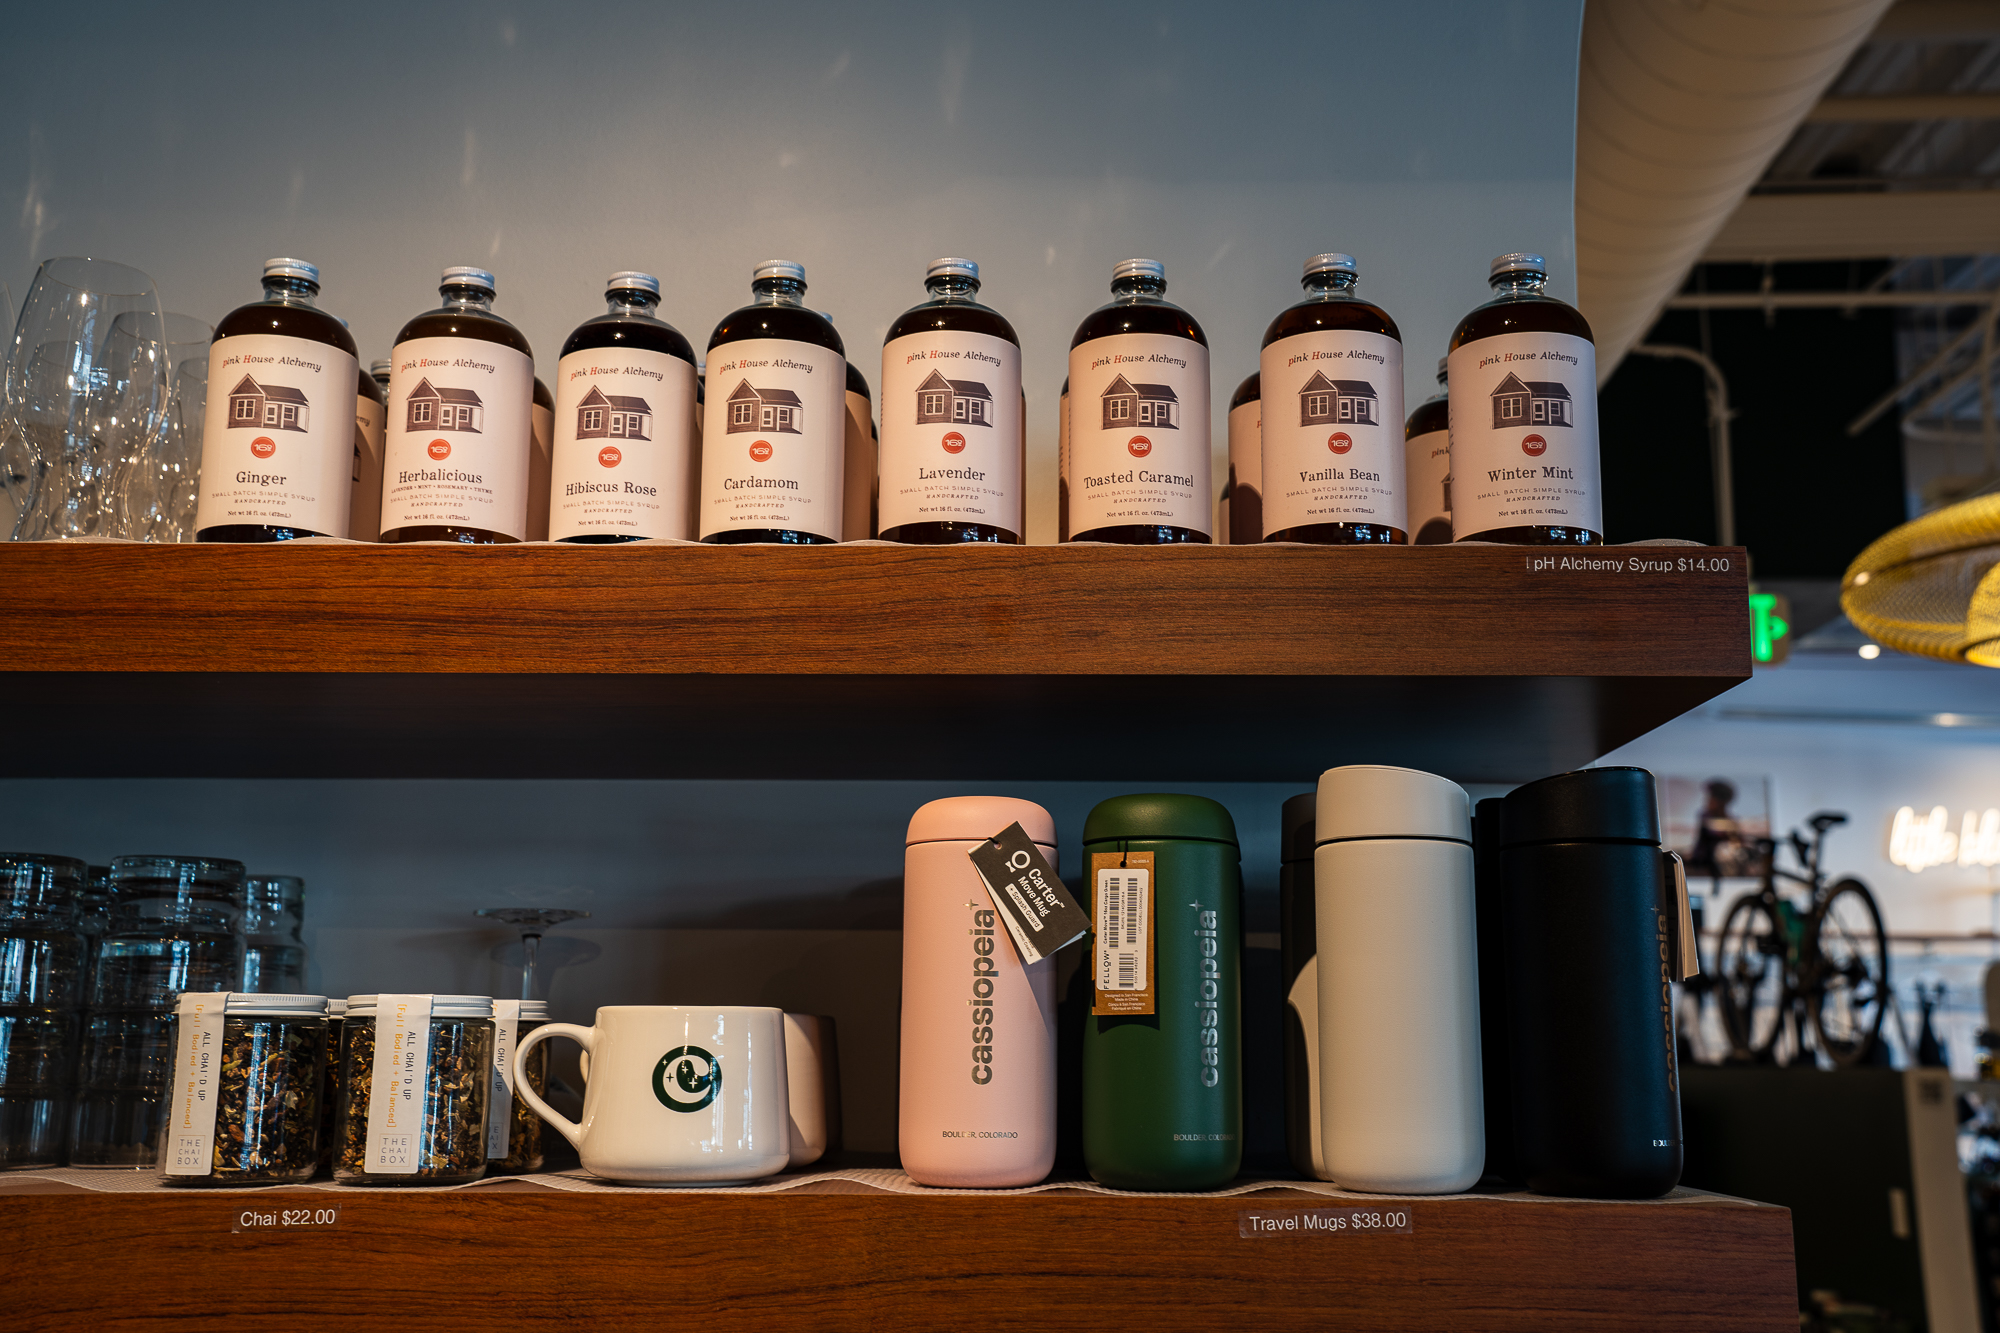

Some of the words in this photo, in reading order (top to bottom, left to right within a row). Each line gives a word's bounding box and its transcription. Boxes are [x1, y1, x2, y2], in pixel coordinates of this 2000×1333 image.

[222, 356, 241, 368] pink
[243, 355, 274, 364] House
[278, 356, 322, 373] Alchemy
[401, 360, 417, 373] pink
[420, 359, 449, 367] House
[452, 359, 495, 373] Alchemy
[907, 351, 927, 364] pink
[929, 350, 960, 359] House
[963, 351, 1001, 367] Alchemy
[1091, 357, 1111, 370] pink
[1114, 355, 1144, 364] House
[1148, 354, 1187, 369] Alchemy
[1288, 353, 1309, 367] pink
[1312, 351, 1343, 360] House
[1347, 350, 1385, 364] Alchemy
[1479, 355, 1501, 369] pink
[1504, 352, 1536, 362] House
[1540, 351, 1578, 366] Alchemy
[570, 368, 587, 381] pink
[590, 367, 619, 375] House
[622, 367, 663, 381] Alchemy
[720, 361, 737, 375] pink
[739, 360, 768, 368] House
[772, 359, 813, 373] Alchemy
[236, 471, 287, 486] Ginger
[399, 469, 483, 484] Herbalicious
[919, 467, 986, 481] Lavender
[1084, 470, 1133, 489] Toasted
[1139, 470, 1194, 487] Caramel
[1300, 468, 1344, 482] Vanilla
[1349, 468, 1380, 482] Bean
[1488, 467, 1537, 482] Winter
[1542, 466, 1573, 480] Mint
[566, 481, 619, 496] Hibiscus
[624, 481, 657, 496] Rose
[724, 476, 799, 490] Cardamom
[291, 494, 316, 502] SYRUP
[983, 488, 1004, 496] SYRUP
[1088, 492, 1109, 500] SMALL
[1477, 491, 1500, 500] SMALL
[468, 496, 494, 504] SYRUP
[1534, 557, 1555, 571] pH
[1560, 557, 1623, 572] Alchemy
[1629, 558, 1673, 573] Syrup
[1677, 558, 1730, 572] $14.00
[1018, 876, 1036, 899] Move
[1032, 897, 1051, 918] Mug
[1011, 891, 1027, 911] Splash
[1025, 909, 1040, 928] Guard
[966, 909, 999, 1085] cassiopeia
[1194, 910, 1220, 1087] cassiopeia
[202, 1032, 211, 1047] ALL
[407, 1031, 416, 1047] ALL
[499, 1029, 507, 1043] ALL
[190, 1034, 199, 1067] Bodied
[393, 1033, 403, 1066] Bodied
[199, 1052, 210, 1085] CHAI'D
[404, 1052, 415, 1084] CHAI'D
[403, 1089, 411, 1100] UP
[495, 1082, 502, 1092] UP
[198, 1090, 205, 1101] UP
[979, 1131, 1018, 1139] COLORADO
[179, 1139, 201, 1147] THE
[177, 1157, 199, 1165] BOX
[240, 1211, 277, 1227] Chai
[282, 1209, 336, 1226] $22.00
[1249, 1216, 1299, 1231] Travel
[1304, 1214, 1347, 1231] Mugs
[1351, 1212, 1406, 1230] $38.00
